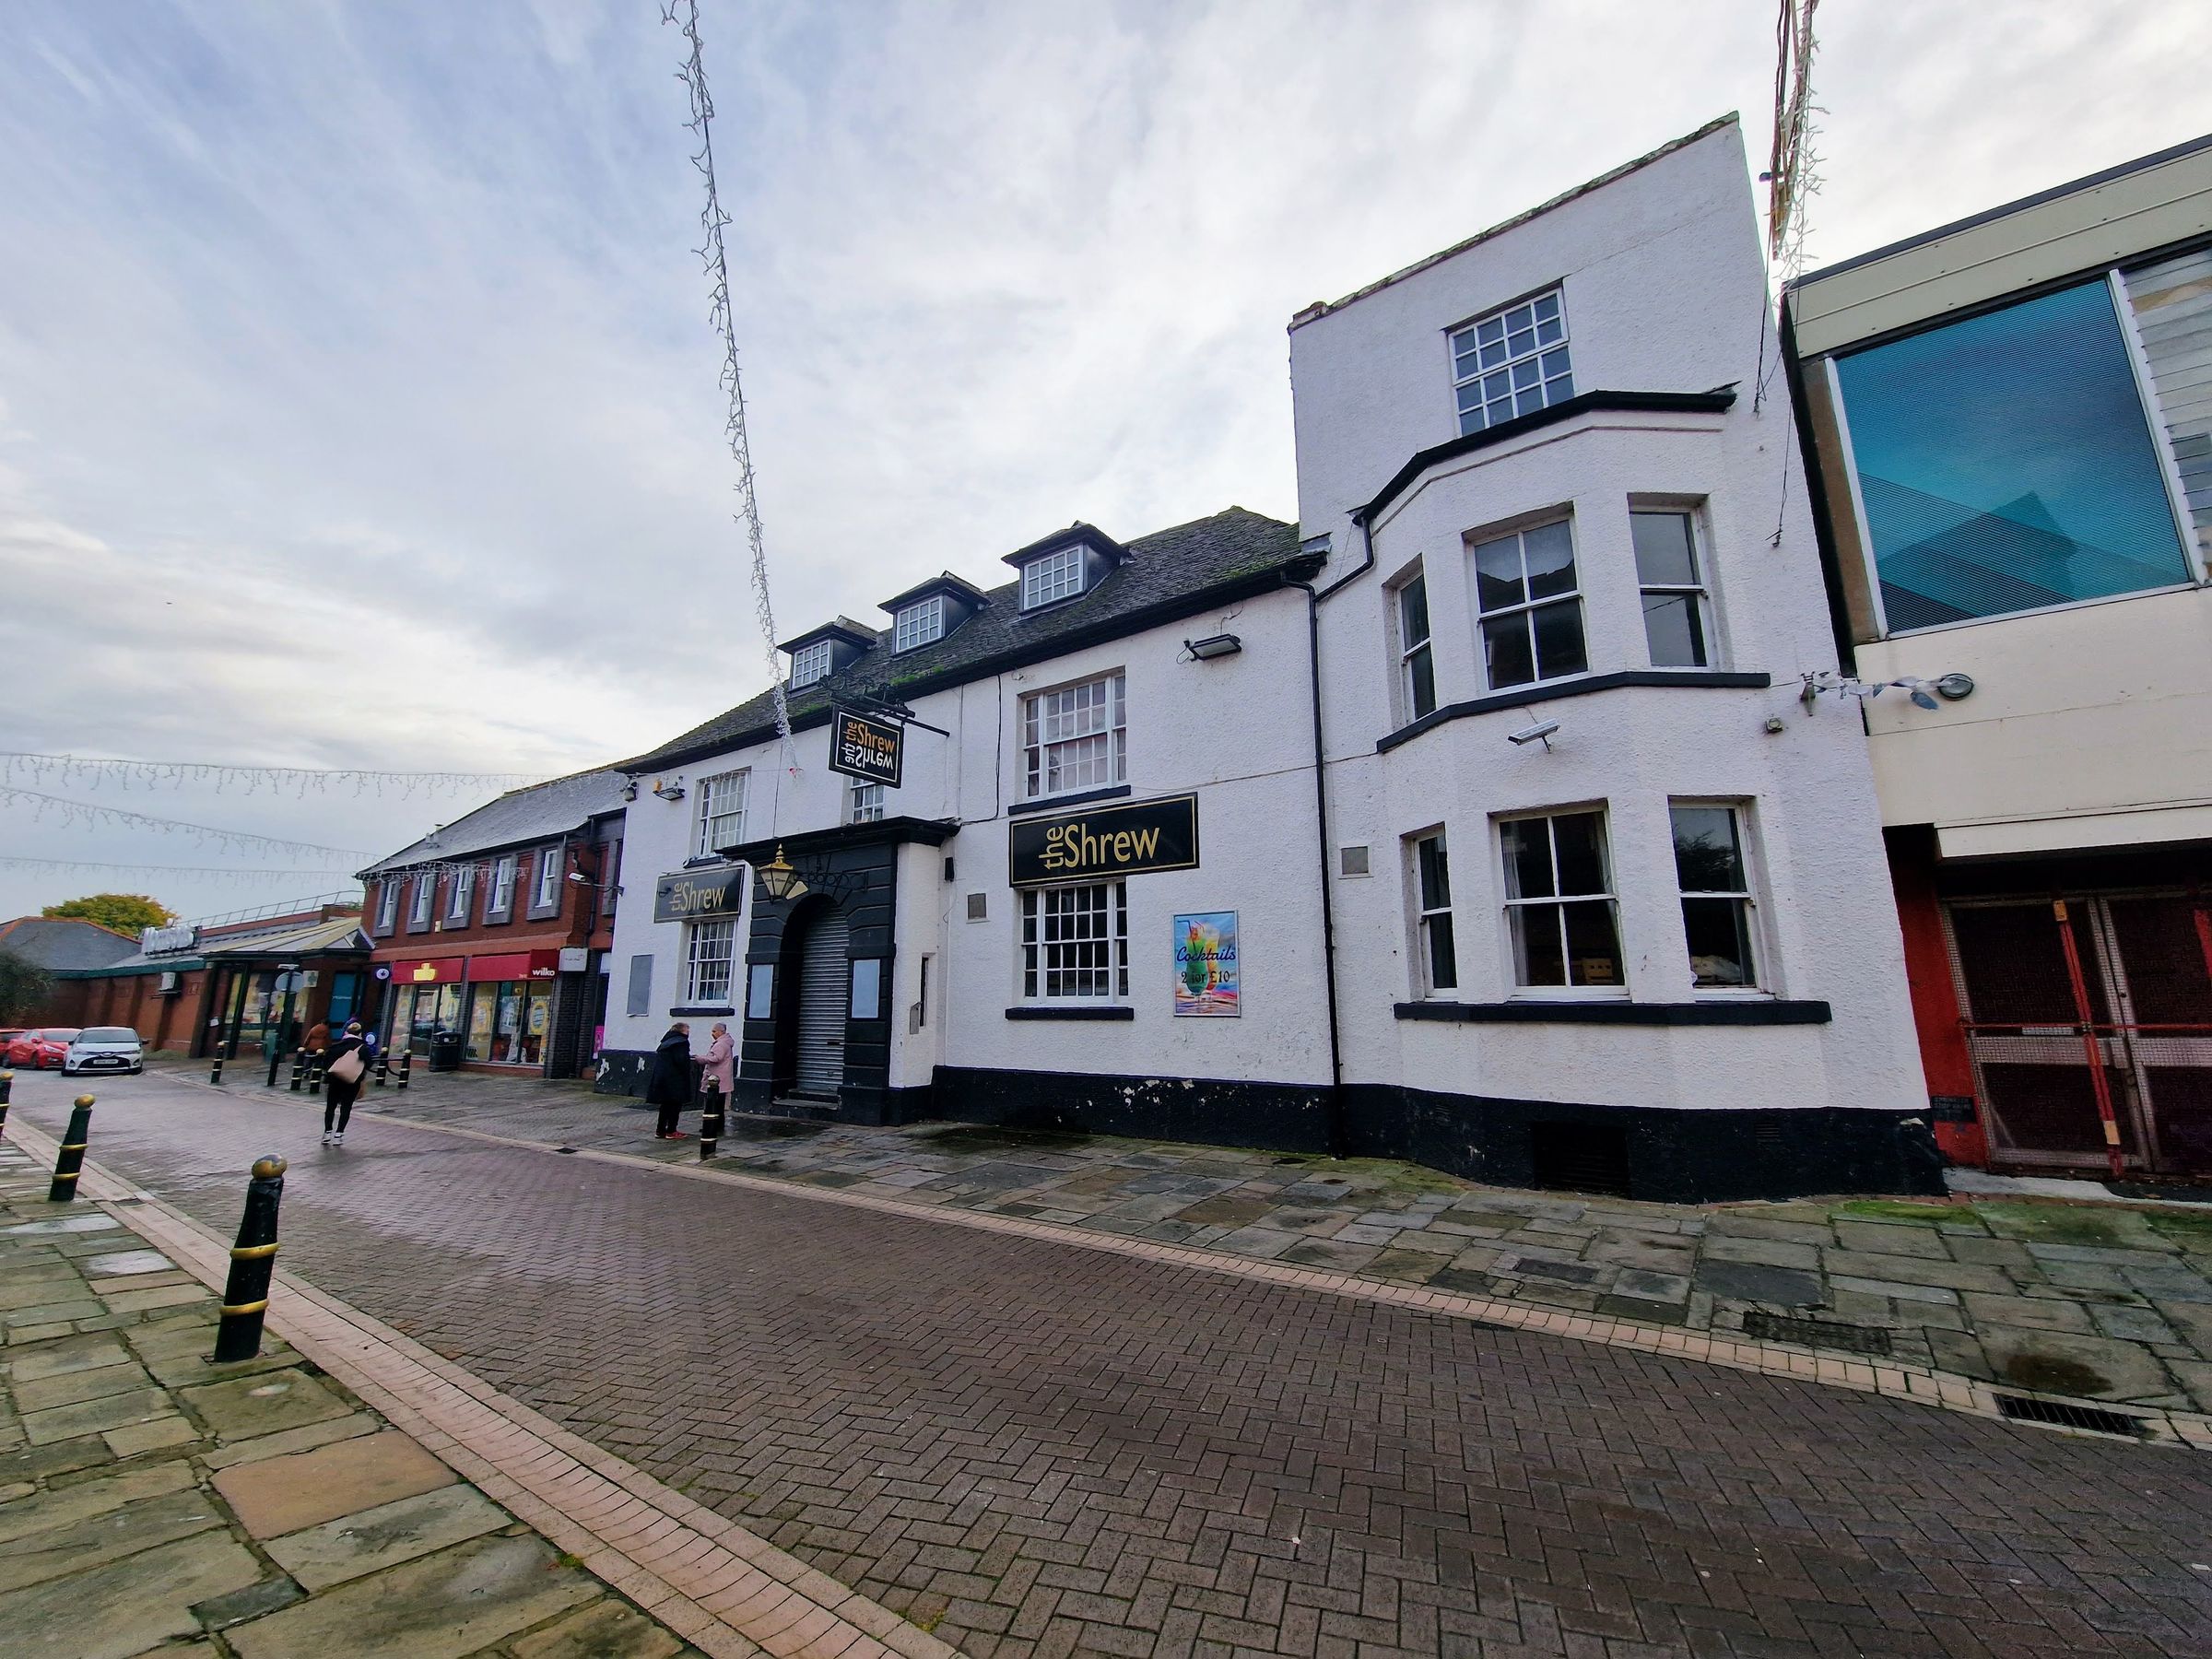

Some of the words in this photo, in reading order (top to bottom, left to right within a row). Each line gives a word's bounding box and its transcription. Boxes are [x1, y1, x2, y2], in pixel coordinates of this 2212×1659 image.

[842, 722, 857, 741] the
[857, 724, 895, 753] Shrew
[1039, 826, 1064, 870] the
[1065, 823, 1159, 868] Shrew
[669, 882, 683, 911] the
[681, 881, 725, 911] Shrew
[1177, 946, 1236, 961] Cocktails
[532, 967, 555, 976] wilko
[1182, 971, 1187, 983] 2
[1192, 971, 1206, 983] for
[1210, 971, 1230, 983] £10
